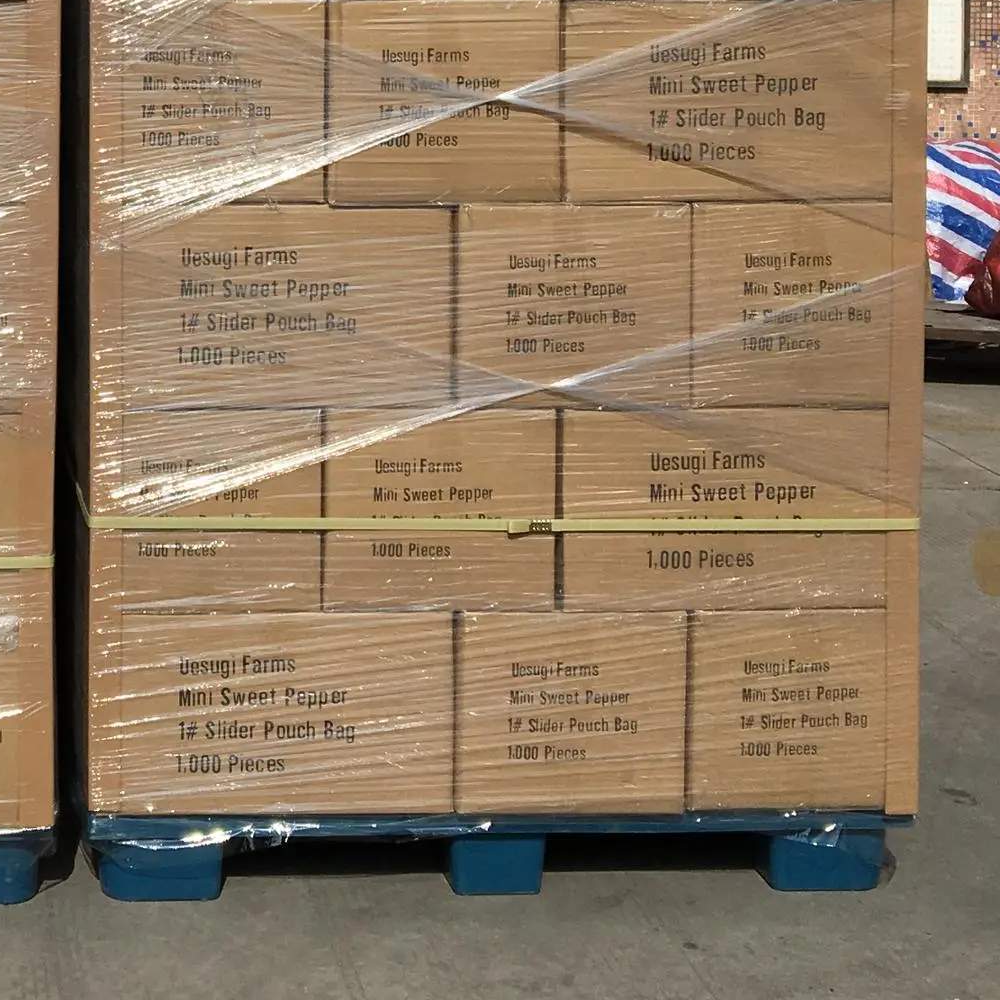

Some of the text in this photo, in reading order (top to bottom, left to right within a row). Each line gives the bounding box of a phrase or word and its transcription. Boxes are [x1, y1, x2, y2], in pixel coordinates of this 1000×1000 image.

[650, 43, 766, 66] Uesugi Farms
[649, 75, 818, 96] Mini Sweet Pepper
[649, 108, 825, 130] 1# Slider Pouch Bag
[699, 143, 755, 161] Pieces
[509, 254, 596, 272] Uesugi Farms
[507, 283, 627, 298] Mini Sweet Pepper
[506, 310, 636, 326] 1# Slider Pouch Bag
[543, 339, 585, 353] Pieces
[375, 459, 462, 476] Uesugi Farms
[651, 451, 765, 475] Uesugi Farms
[373, 487, 493, 502] Mini Sweet Pepper
[650, 483, 816, 504] Mini Sweet Pepper
[408, 542, 450, 557] Pieces
[699, 550, 754, 568] Pieces
[511, 662, 599, 680] Uesugi Farms
[510, 690, 630, 705] Mini Sweet Pepper
[508, 718, 638, 734] 1# Slider Pouch Bag
[544, 746, 586, 760] Pieces
